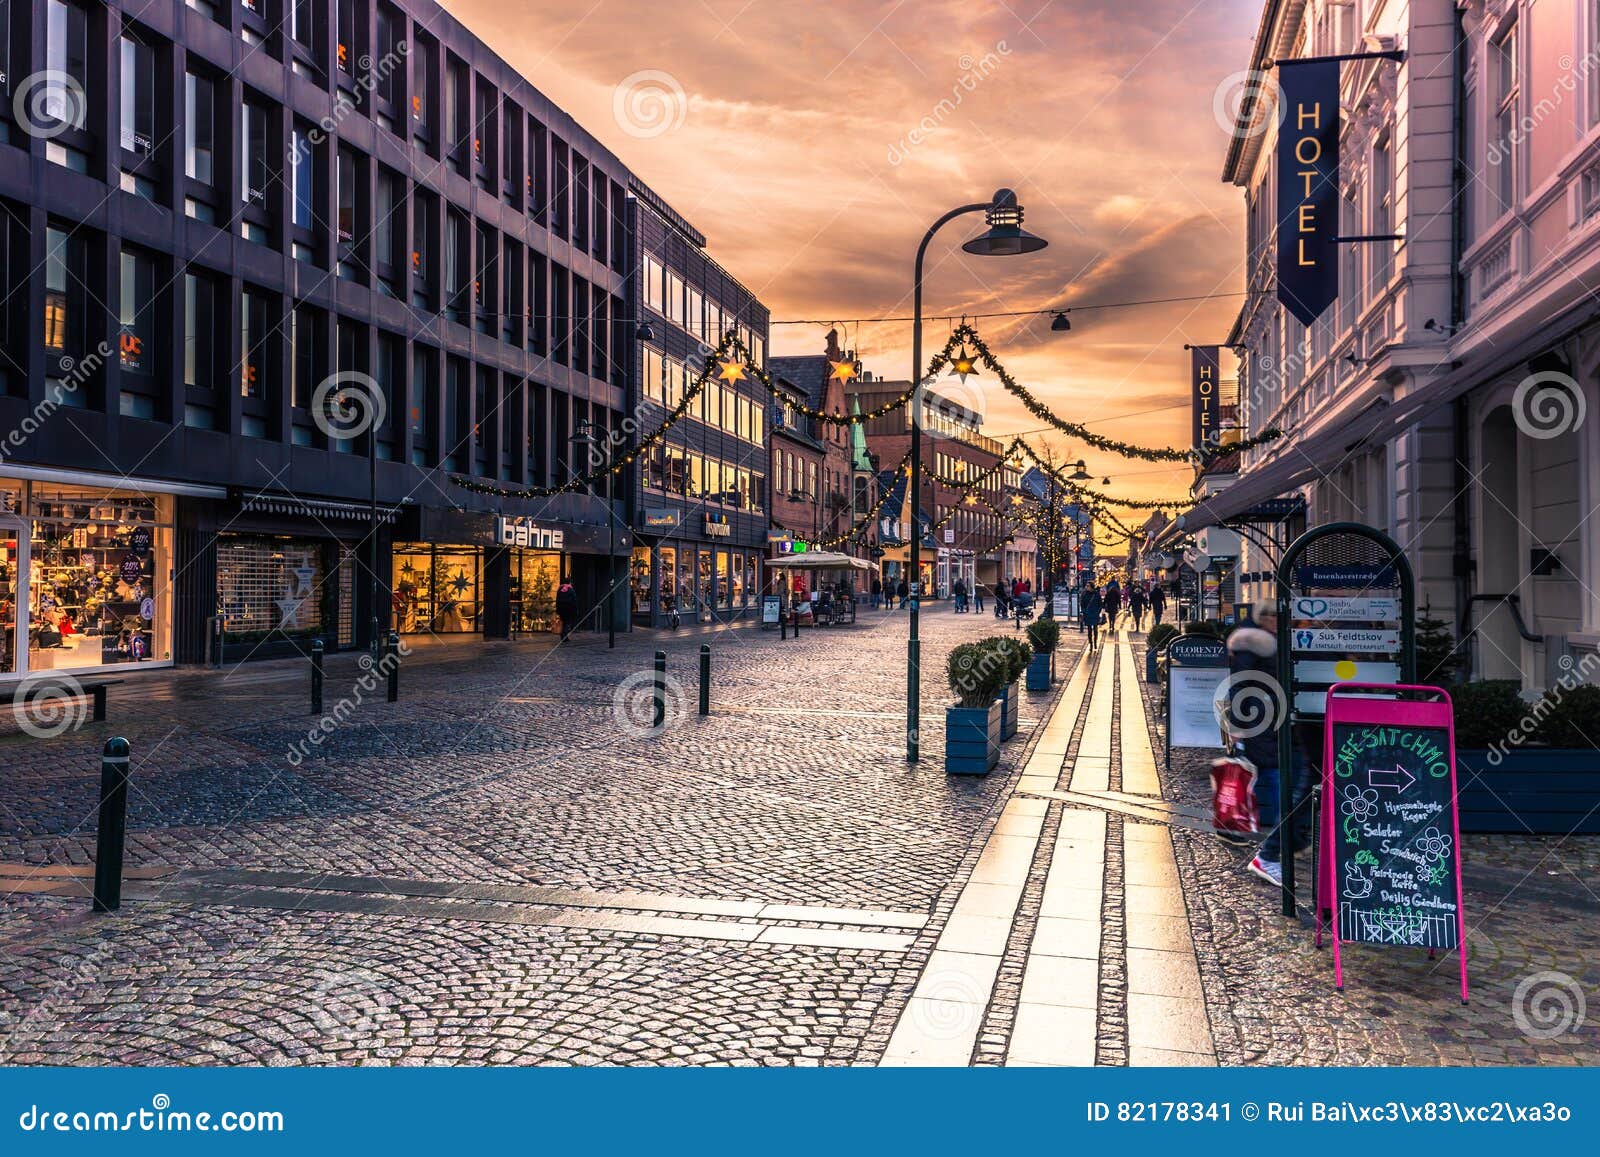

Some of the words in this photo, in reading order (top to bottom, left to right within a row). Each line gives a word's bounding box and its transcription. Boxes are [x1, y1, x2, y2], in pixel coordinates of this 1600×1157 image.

[1295, 102, 1321, 266] HOTEL
[1199, 365, 1213, 442] HOTEL
[502, 517, 564, 549] bahne
[1313, 572, 1377, 580] Rosenhavestræde
[1319, 632, 1335, 641] Sus
[1338, 633, 1383, 641] Feldtskov
[1175, 646, 1225, 654] FLORENTZ
[1361, 728, 1449, 778] SATCHMO
[1363, 822, 1402, 838] Salater
[1391, 878, 1418, 890] Kaffe
